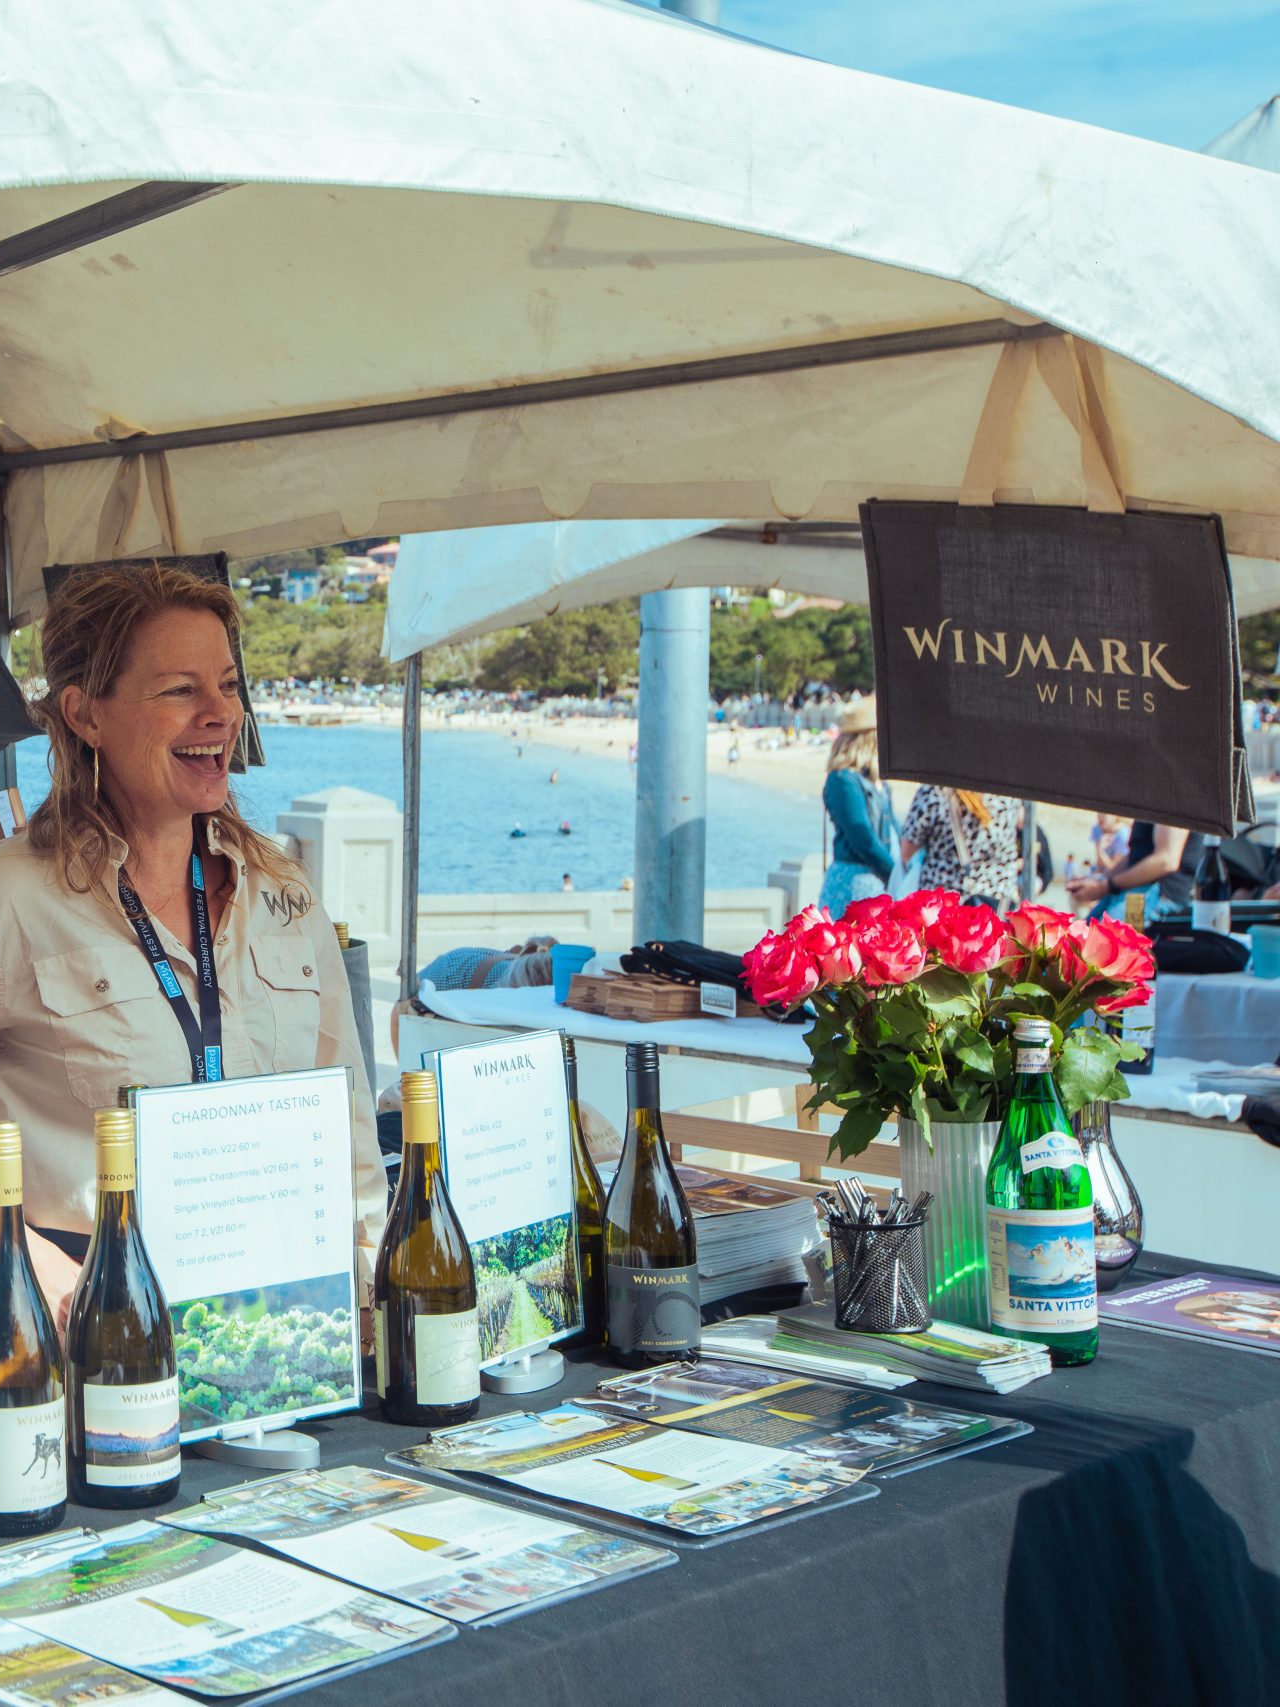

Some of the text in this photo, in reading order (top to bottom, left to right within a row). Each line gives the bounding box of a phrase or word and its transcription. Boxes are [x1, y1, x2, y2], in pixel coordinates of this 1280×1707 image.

[903, 617, 1191, 691] WINMARK
[1036, 683, 1156, 713] WINES
[196, 893, 213, 988] FESTIVAL CURRENCY
[473, 1053, 536, 1079] WINMARK
[504, 1073, 531, 1085] WINES
[172, 1094, 321, 1125] CHARDONNAY TASTING
[173, 1150, 200, 1160] Rusty's
[221, 1144, 237, 1153] V22
[238, 1142, 250, 1151] 60
[1024, 1151, 1053, 1162] SANTA
[174, 1175, 207, 1187] Winmark
[263, 1164, 277, 1174] V21
[278, 1162, 289, 1172] 60
[313, 1157, 323, 1168] $4
[174, 1203, 199, 1214] Single
[201, 1196, 235, 1209] Vineyard
[277, 1188, 289, 1198] 60
[314, 1183, 324, 1193] $4
[210, 1225, 224, 1235] V21
[225, 1223, 237, 1233] 60
[314, 1209, 325, 1219] $8
[197, 1254, 206, 1263] of
[207, 1252, 226, 1262] each
[227, 1248, 245, 1259] wine
[315, 1234, 325, 1245] $4
[633, 1273, 690, 1287] WINMARK
[1009, 1298, 1053, 1312] SANTA
[121, 1386, 176, 1404] WINMARK
